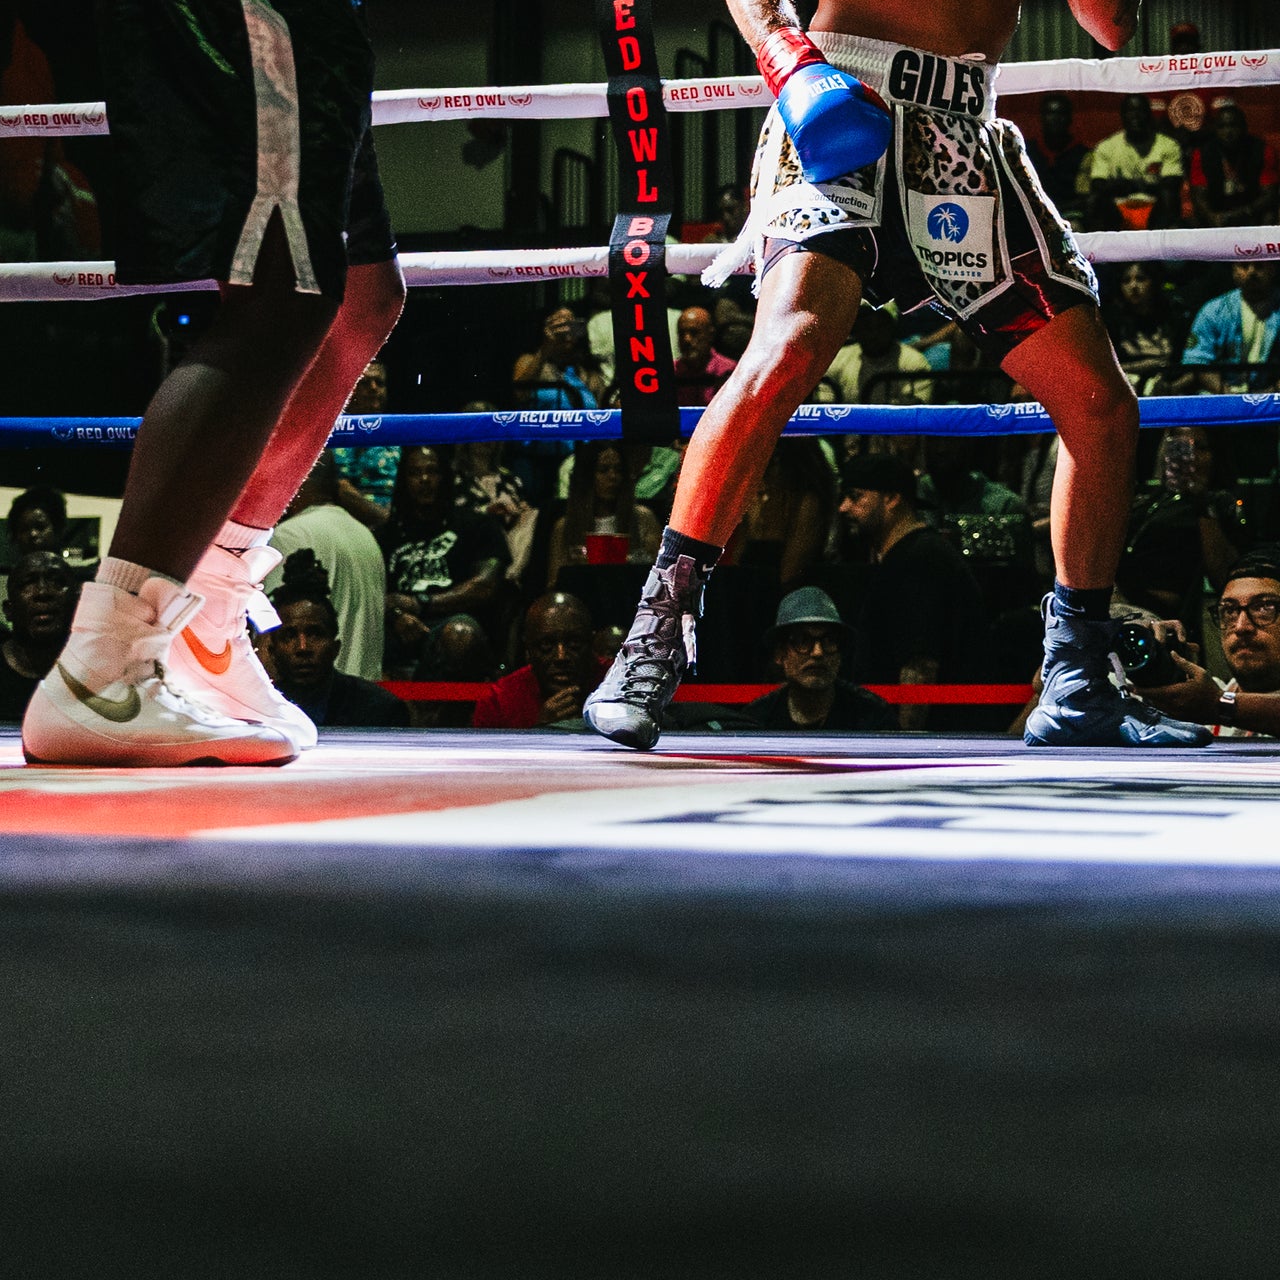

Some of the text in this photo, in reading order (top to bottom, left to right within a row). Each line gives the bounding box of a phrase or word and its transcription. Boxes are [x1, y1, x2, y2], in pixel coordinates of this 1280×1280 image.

[1168, 55, 1237, 71] RED OWL
[888, 49, 986, 117] GILES
[670, 84, 736, 101] RED OWL
[444, 93, 506, 108] RED OWL
[23, 112, 81, 126] RED OWL
[625, 86, 659, 204] OWL
[915, 244, 988, 269] TROPICS
[515, 265, 581, 277] RED OWL
[942, 269, 982, 278] PLASTER
[77, 272, 105, 286] RED
[623, 216, 660, 395] BOXING
[519, 410, 584, 423] RED OWL
[76, 426, 136, 440] RED OWL
